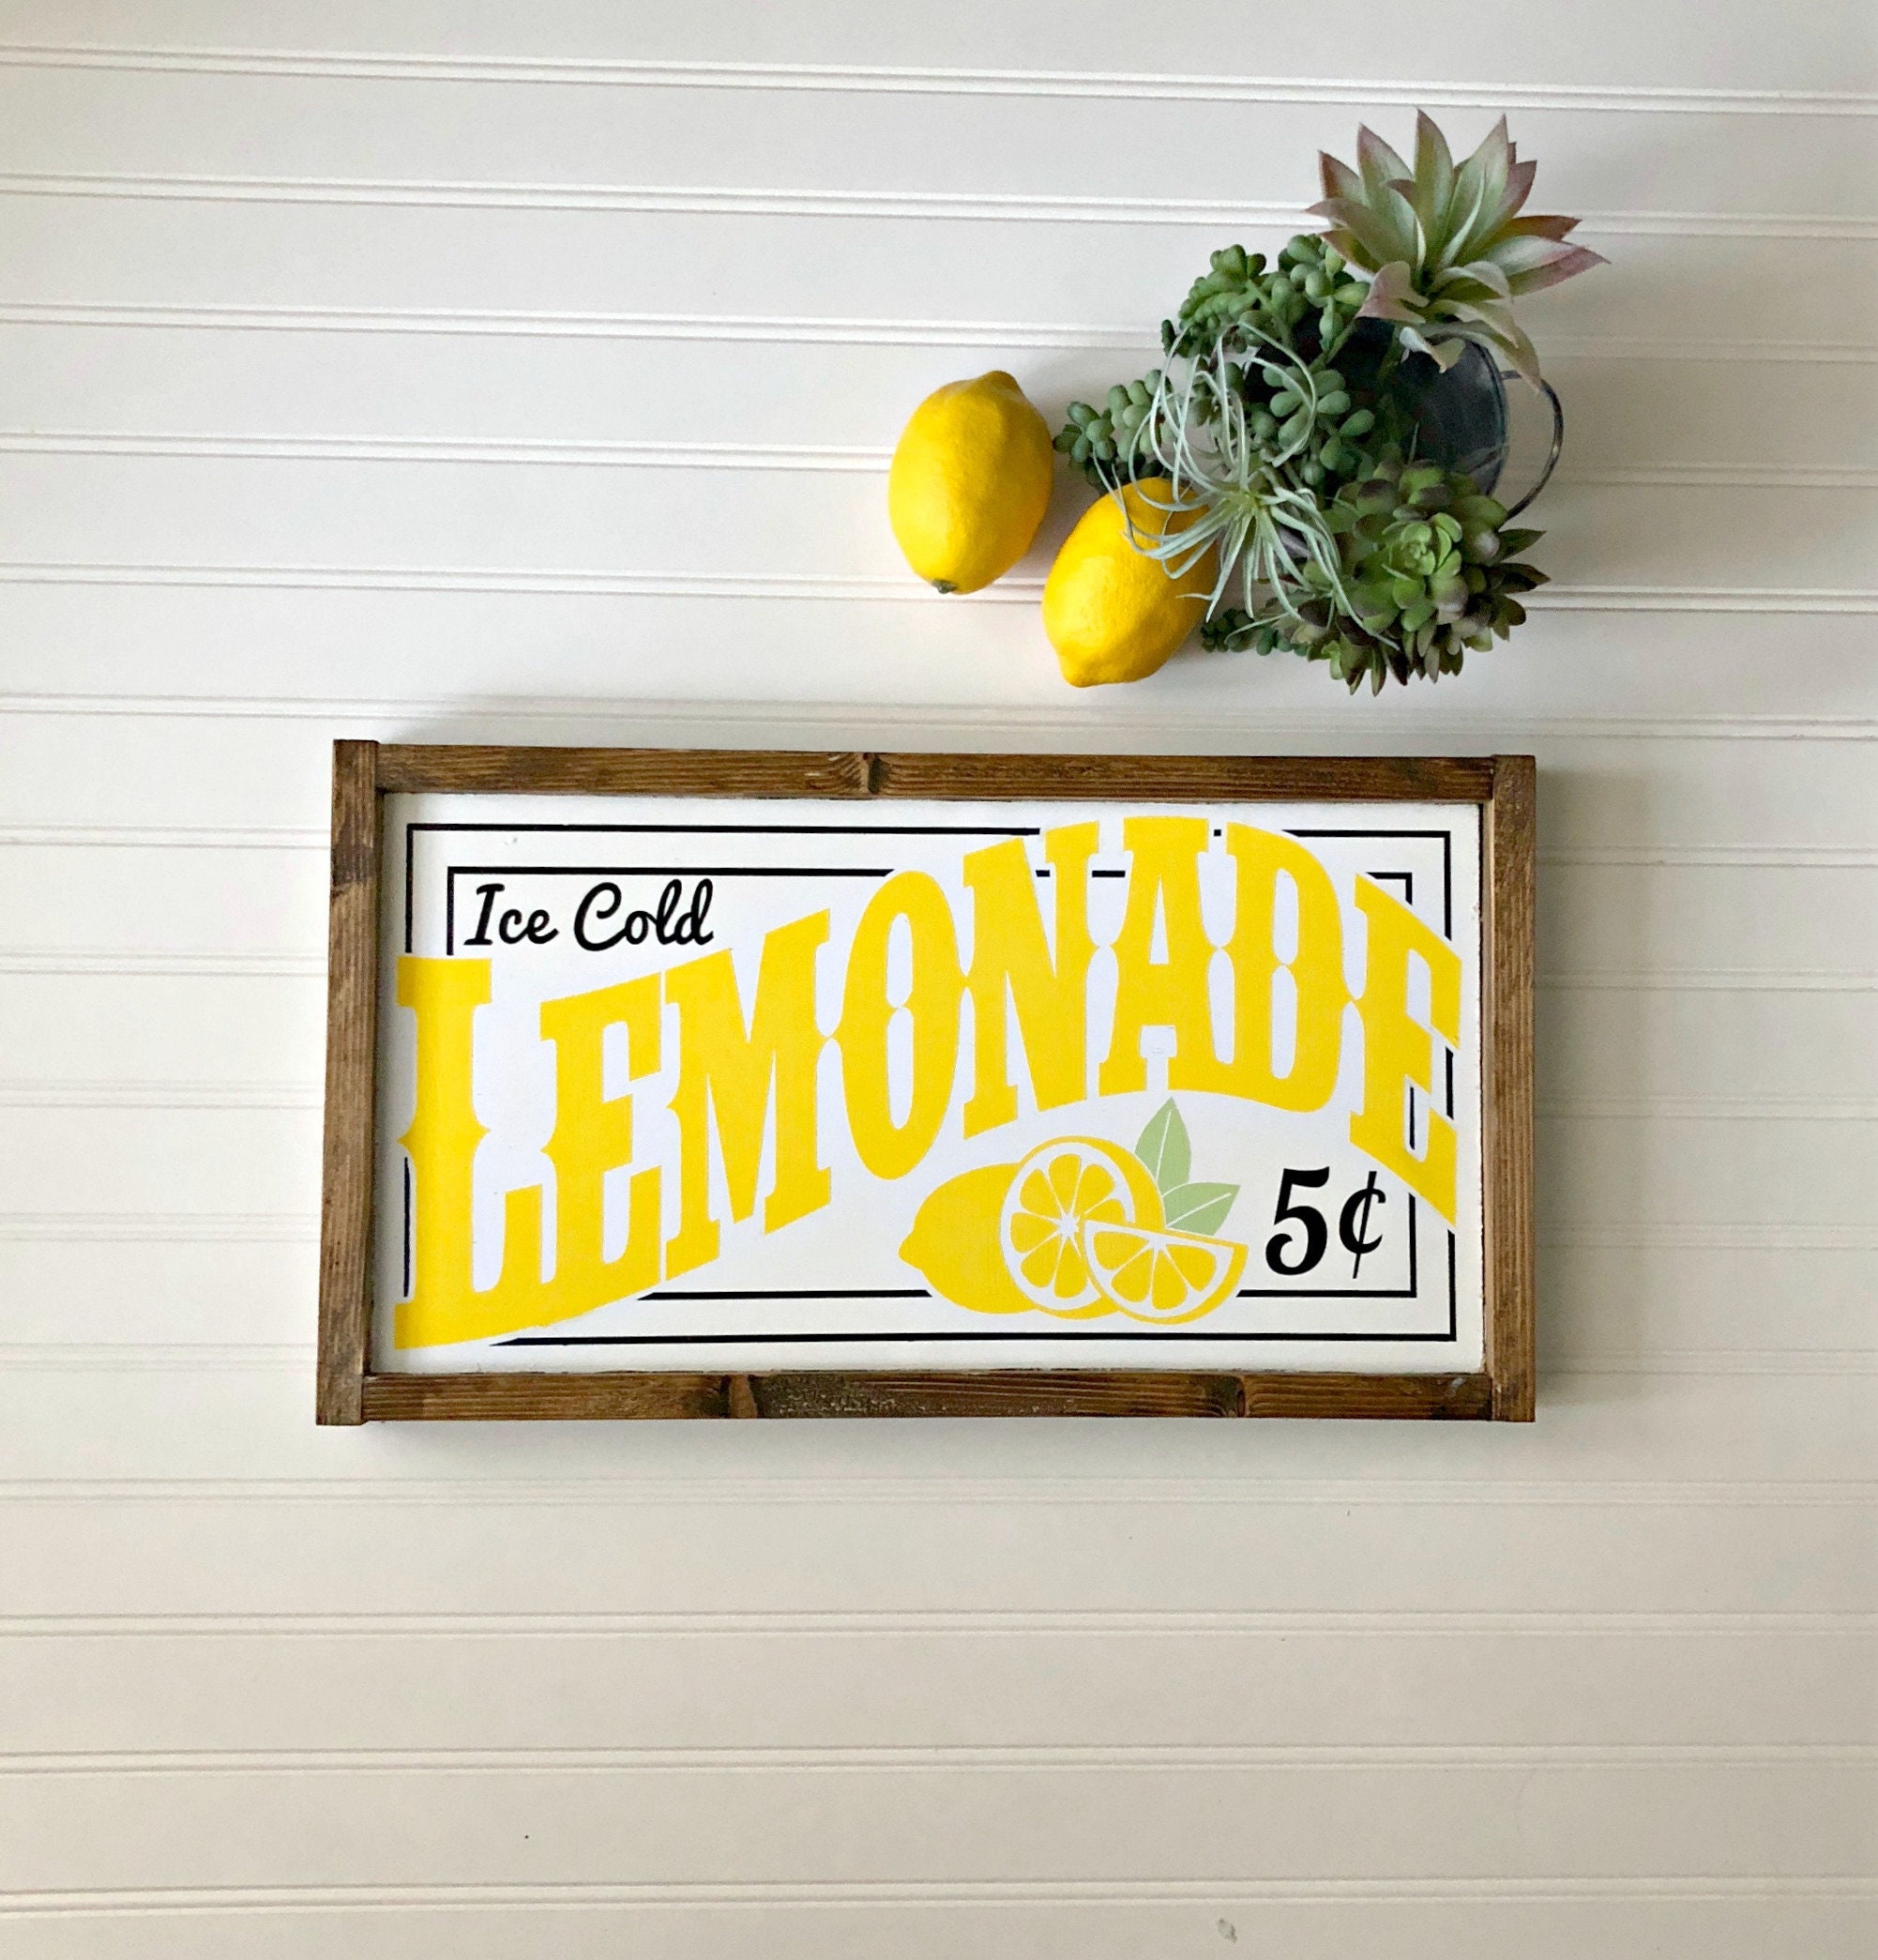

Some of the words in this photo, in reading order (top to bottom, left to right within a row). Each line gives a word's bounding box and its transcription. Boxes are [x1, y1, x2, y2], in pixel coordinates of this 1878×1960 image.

[463, 883, 559, 946] Ice
[573, 878, 714, 951] Cold
[394, 815, 1462, 1350] LEMONADE
[1265, 1165, 1386, 1280] 5¢
